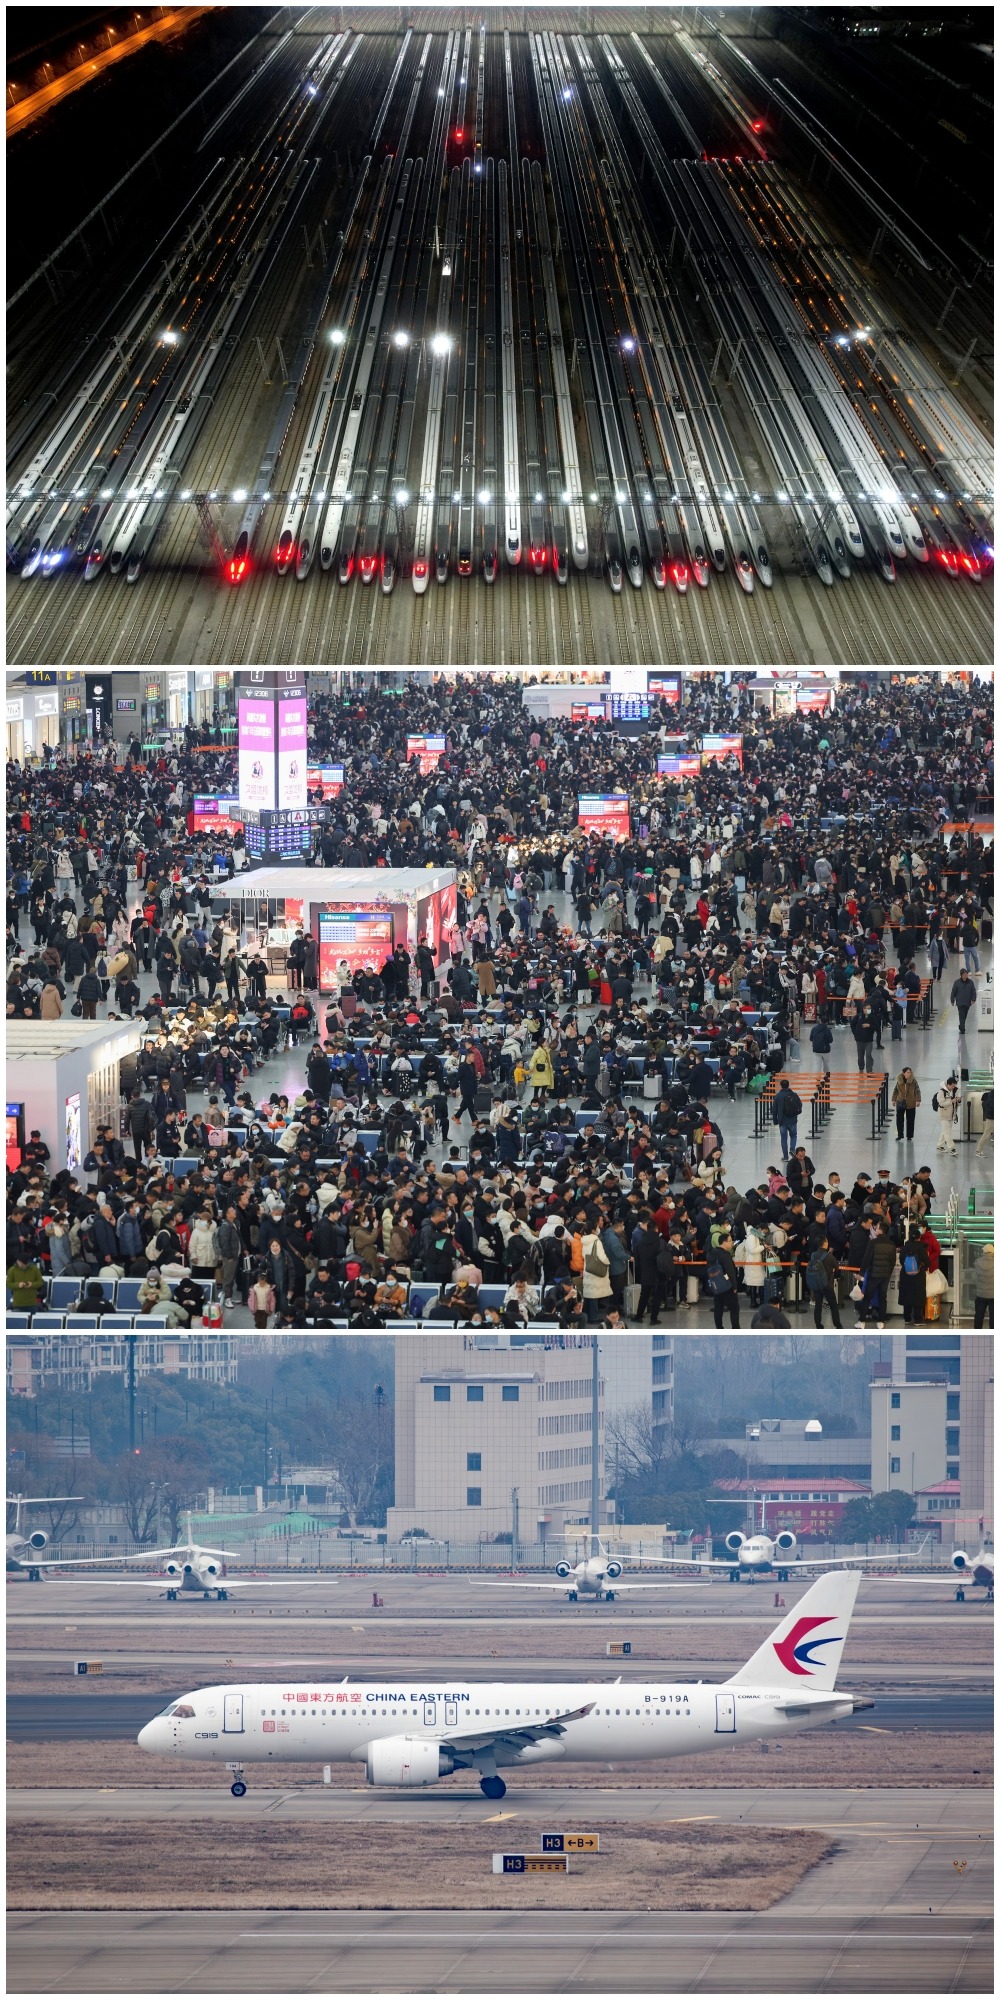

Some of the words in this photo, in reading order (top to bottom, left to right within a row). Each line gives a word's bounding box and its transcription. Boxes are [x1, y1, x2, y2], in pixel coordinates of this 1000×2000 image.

[242, 889, 270, 898] DIOR
[282, 1692, 362, 1702] 中國東方航空
[366, 1693, 406, 1701] CHINA
[410, 1693, 470, 1701] EASTERN
[546, 1838, 561, 1848] H3
[577, 1838, 584, 1848] B
[506, 1859, 522, 1869] H3
